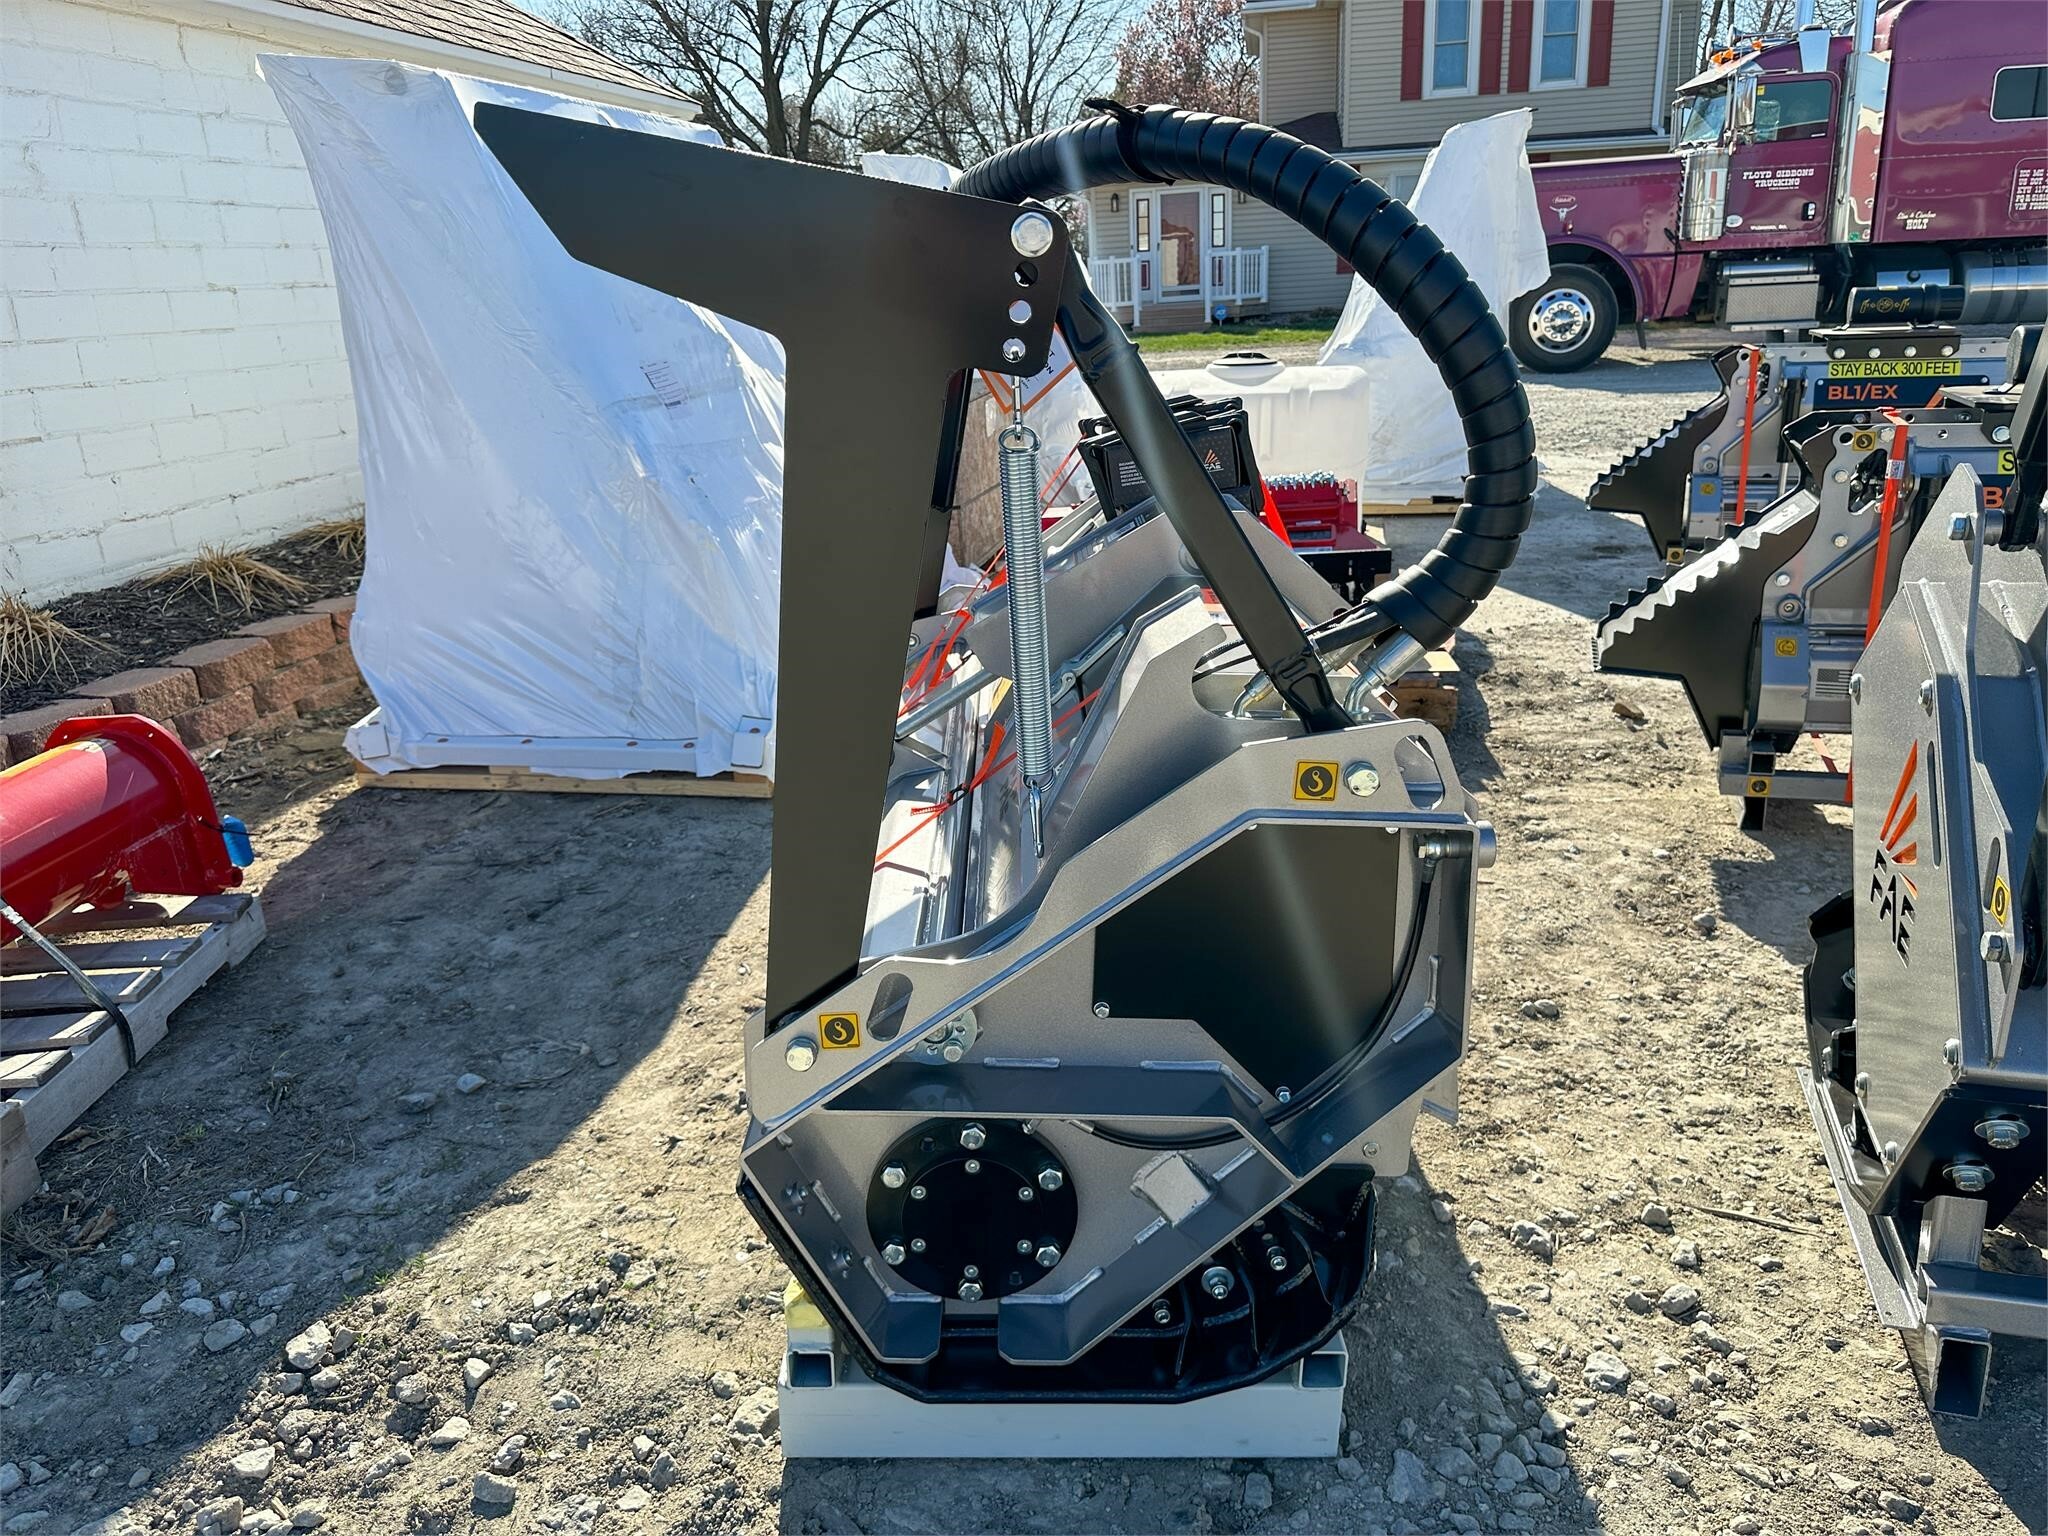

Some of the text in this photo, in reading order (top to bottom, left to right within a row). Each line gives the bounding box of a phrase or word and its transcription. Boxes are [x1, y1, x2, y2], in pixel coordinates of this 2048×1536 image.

[1742, 168, 1814, 179] FLOYD GIBBONS
[1754, 178, 1800, 187] TRUCKING
[1906, 218, 1929, 230] HOLT
[1830, 361, 1959, 377] STAY BACK 300 FEET
[1828, 383, 1898, 401] BL1/EX
